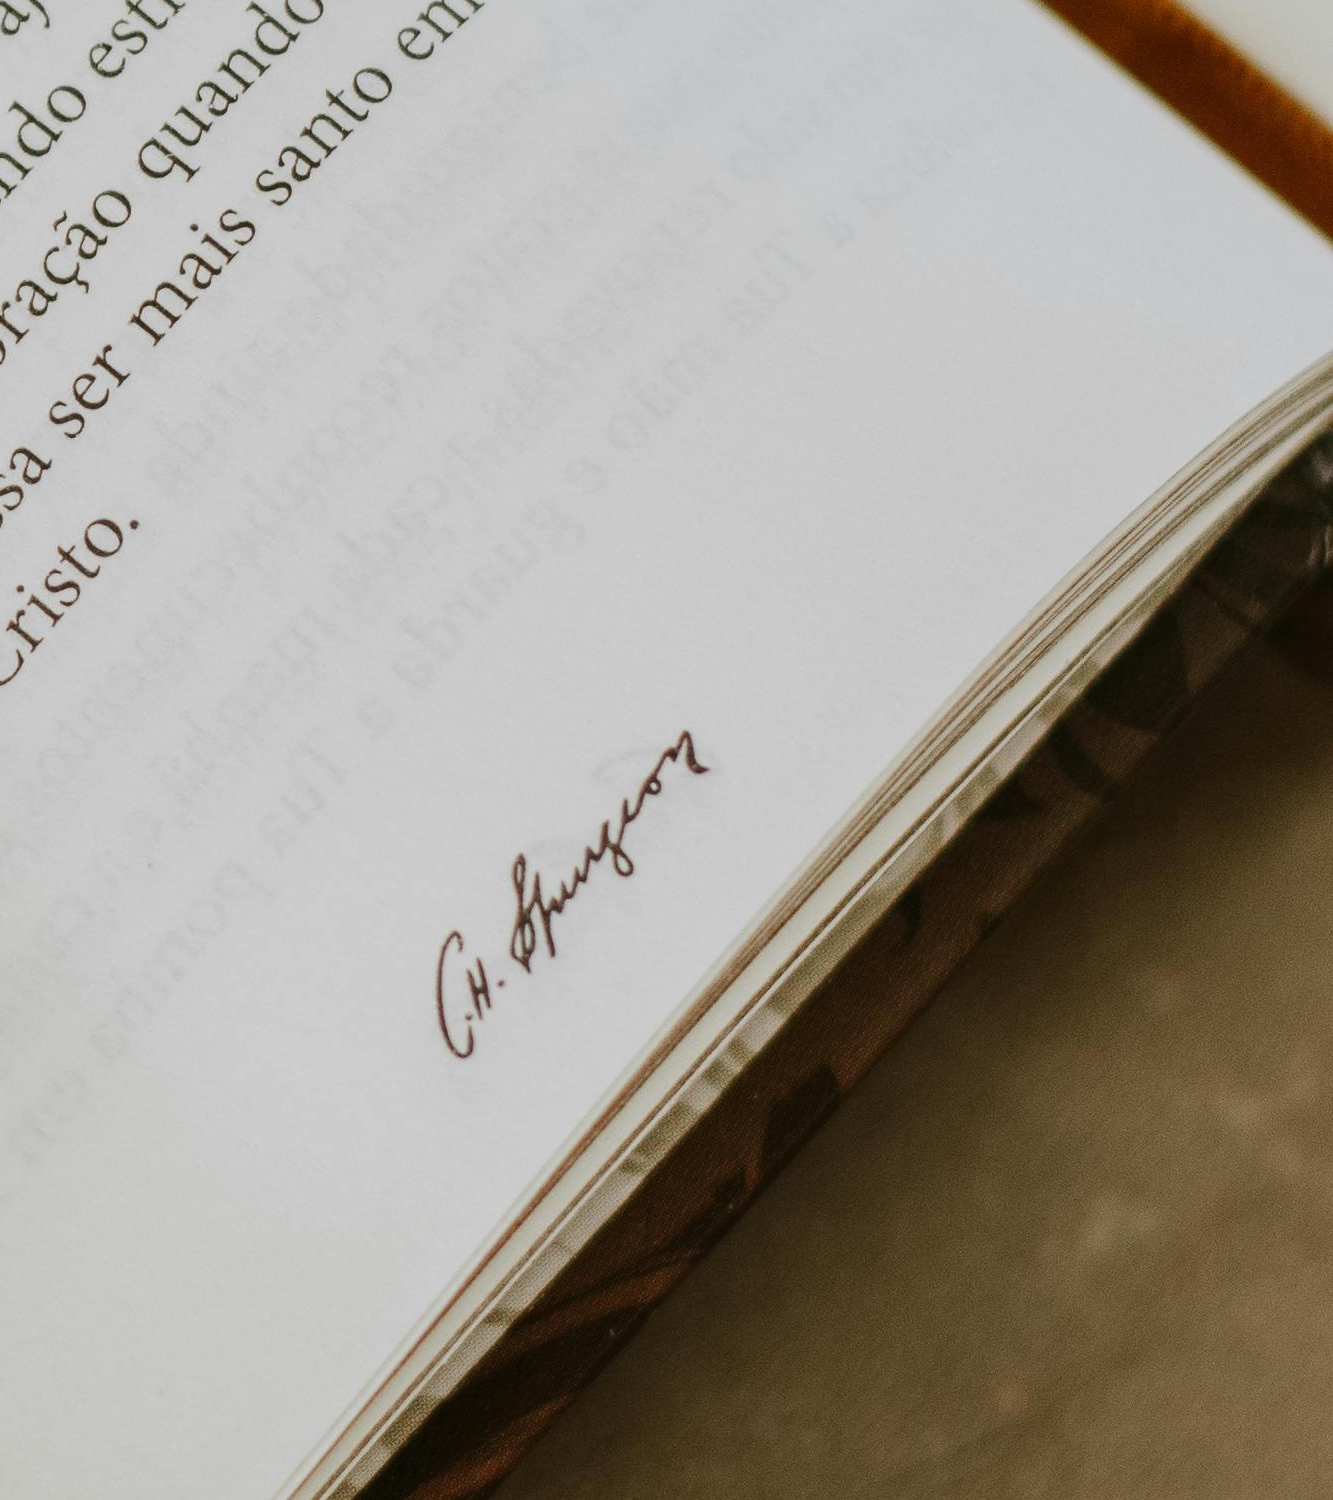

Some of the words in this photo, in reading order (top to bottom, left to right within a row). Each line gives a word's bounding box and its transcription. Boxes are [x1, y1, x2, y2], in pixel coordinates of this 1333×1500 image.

[47, 343, 131, 440] ser
[128, 207, 257, 347] mais
[254, 66, 393, 207] santo
